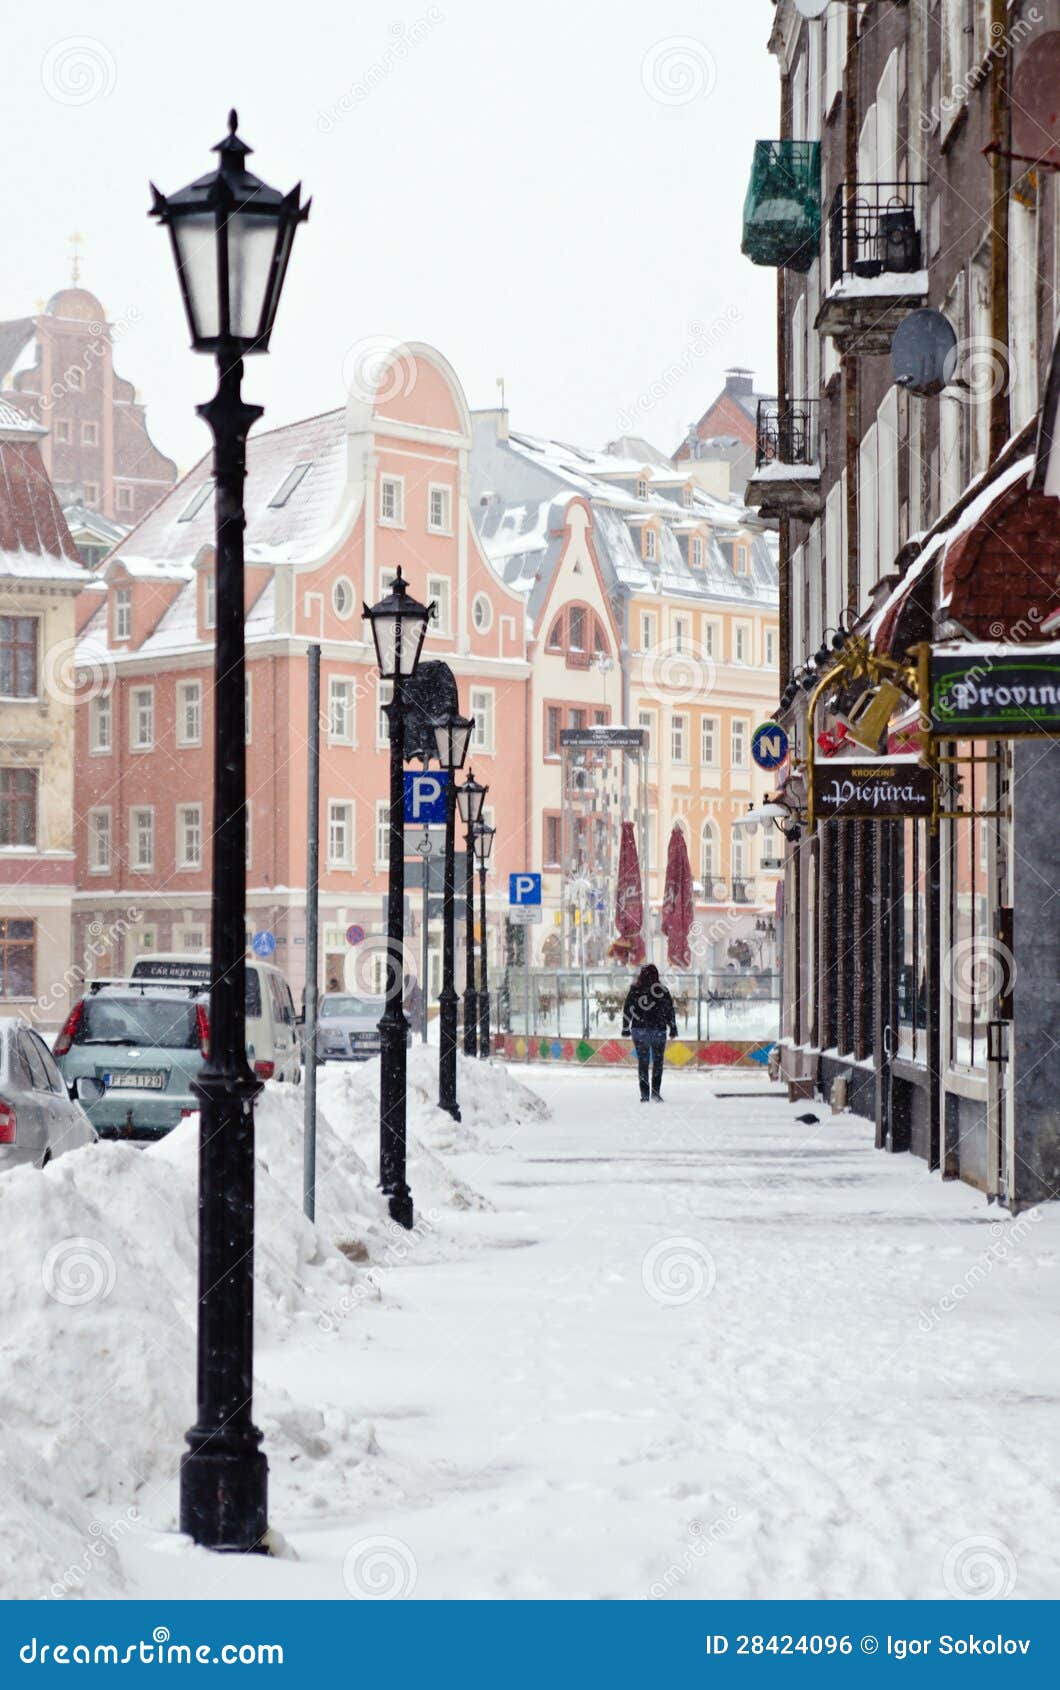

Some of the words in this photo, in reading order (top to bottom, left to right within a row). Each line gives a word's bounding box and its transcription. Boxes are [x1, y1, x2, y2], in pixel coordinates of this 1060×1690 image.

[760, 735, 780, 758] N
[412, 776, 441, 818] P
[516, 876, 535, 902] P
[151, 967, 168, 975] CAR
